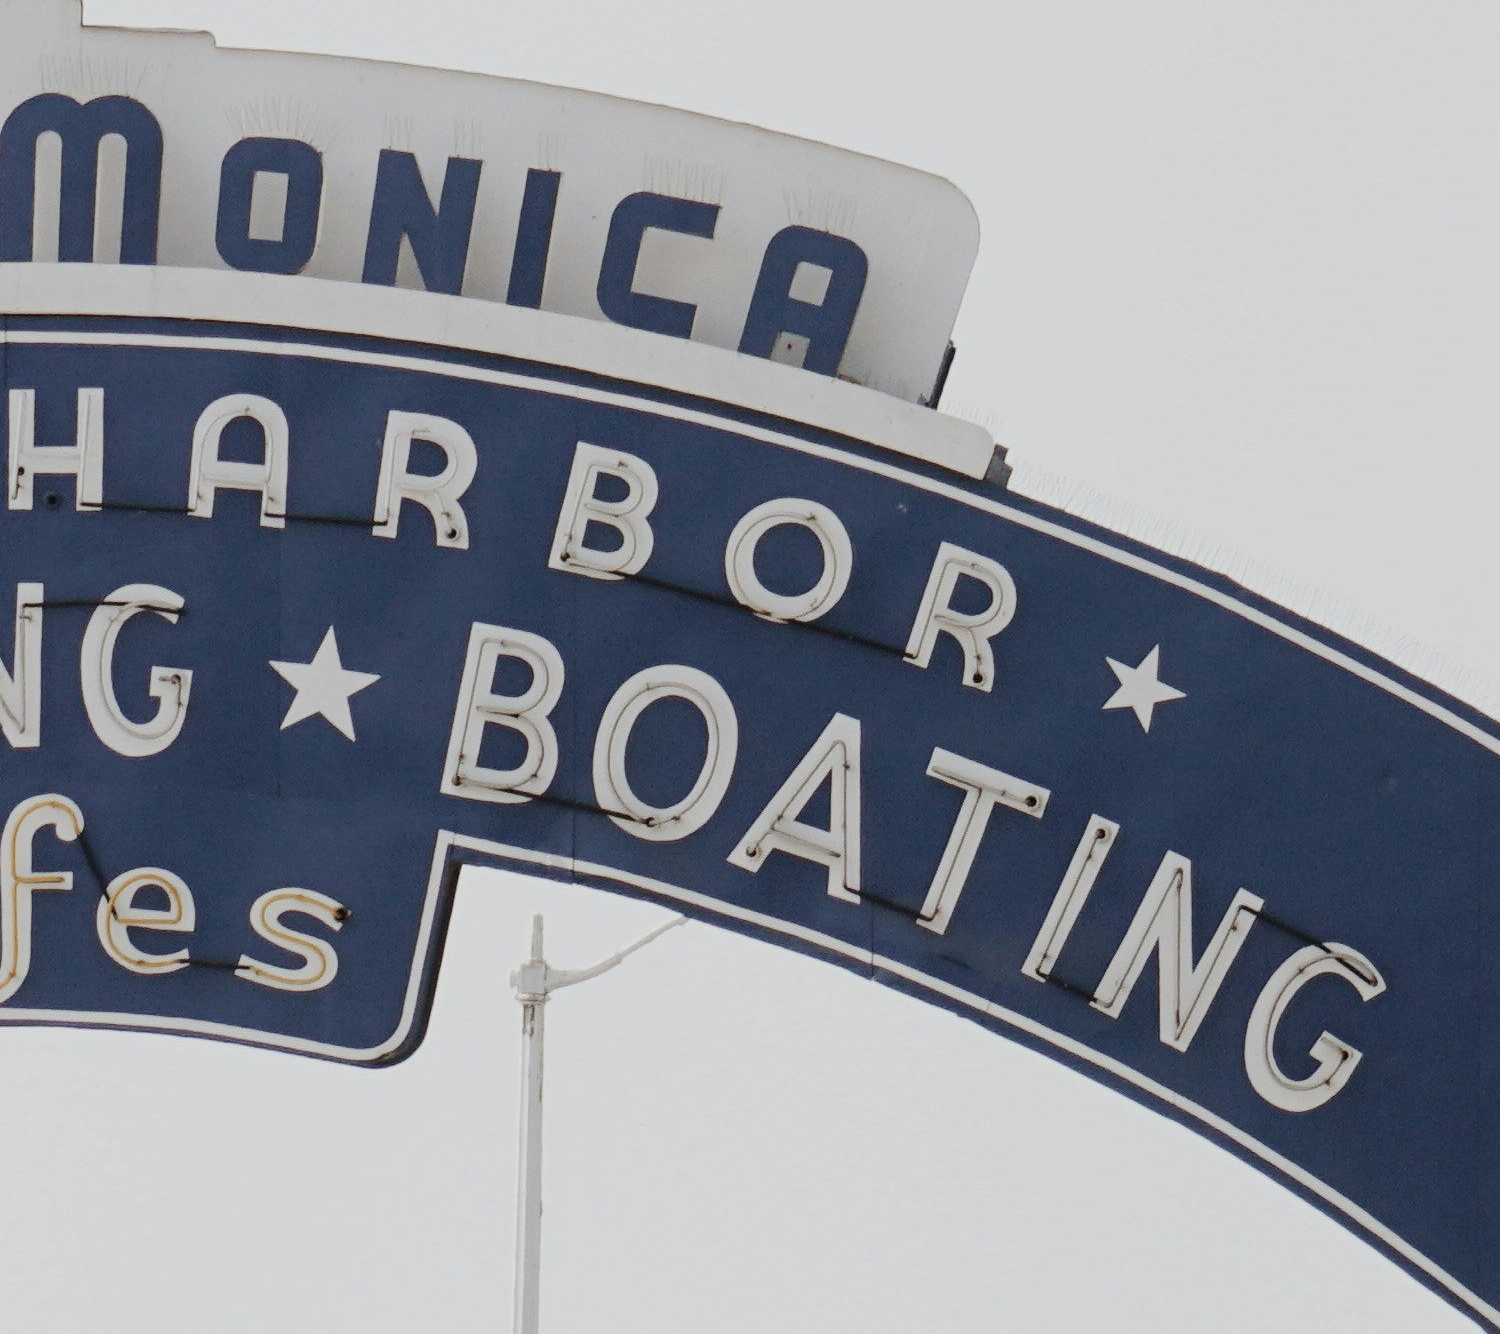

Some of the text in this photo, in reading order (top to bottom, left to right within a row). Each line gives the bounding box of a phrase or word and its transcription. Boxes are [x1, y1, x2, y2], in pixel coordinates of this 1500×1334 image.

[0, 92, 869, 380] MONICA
[6, 387, 1018, 693] HARBOR
[440, 622, 1388, 1114] BOATING
